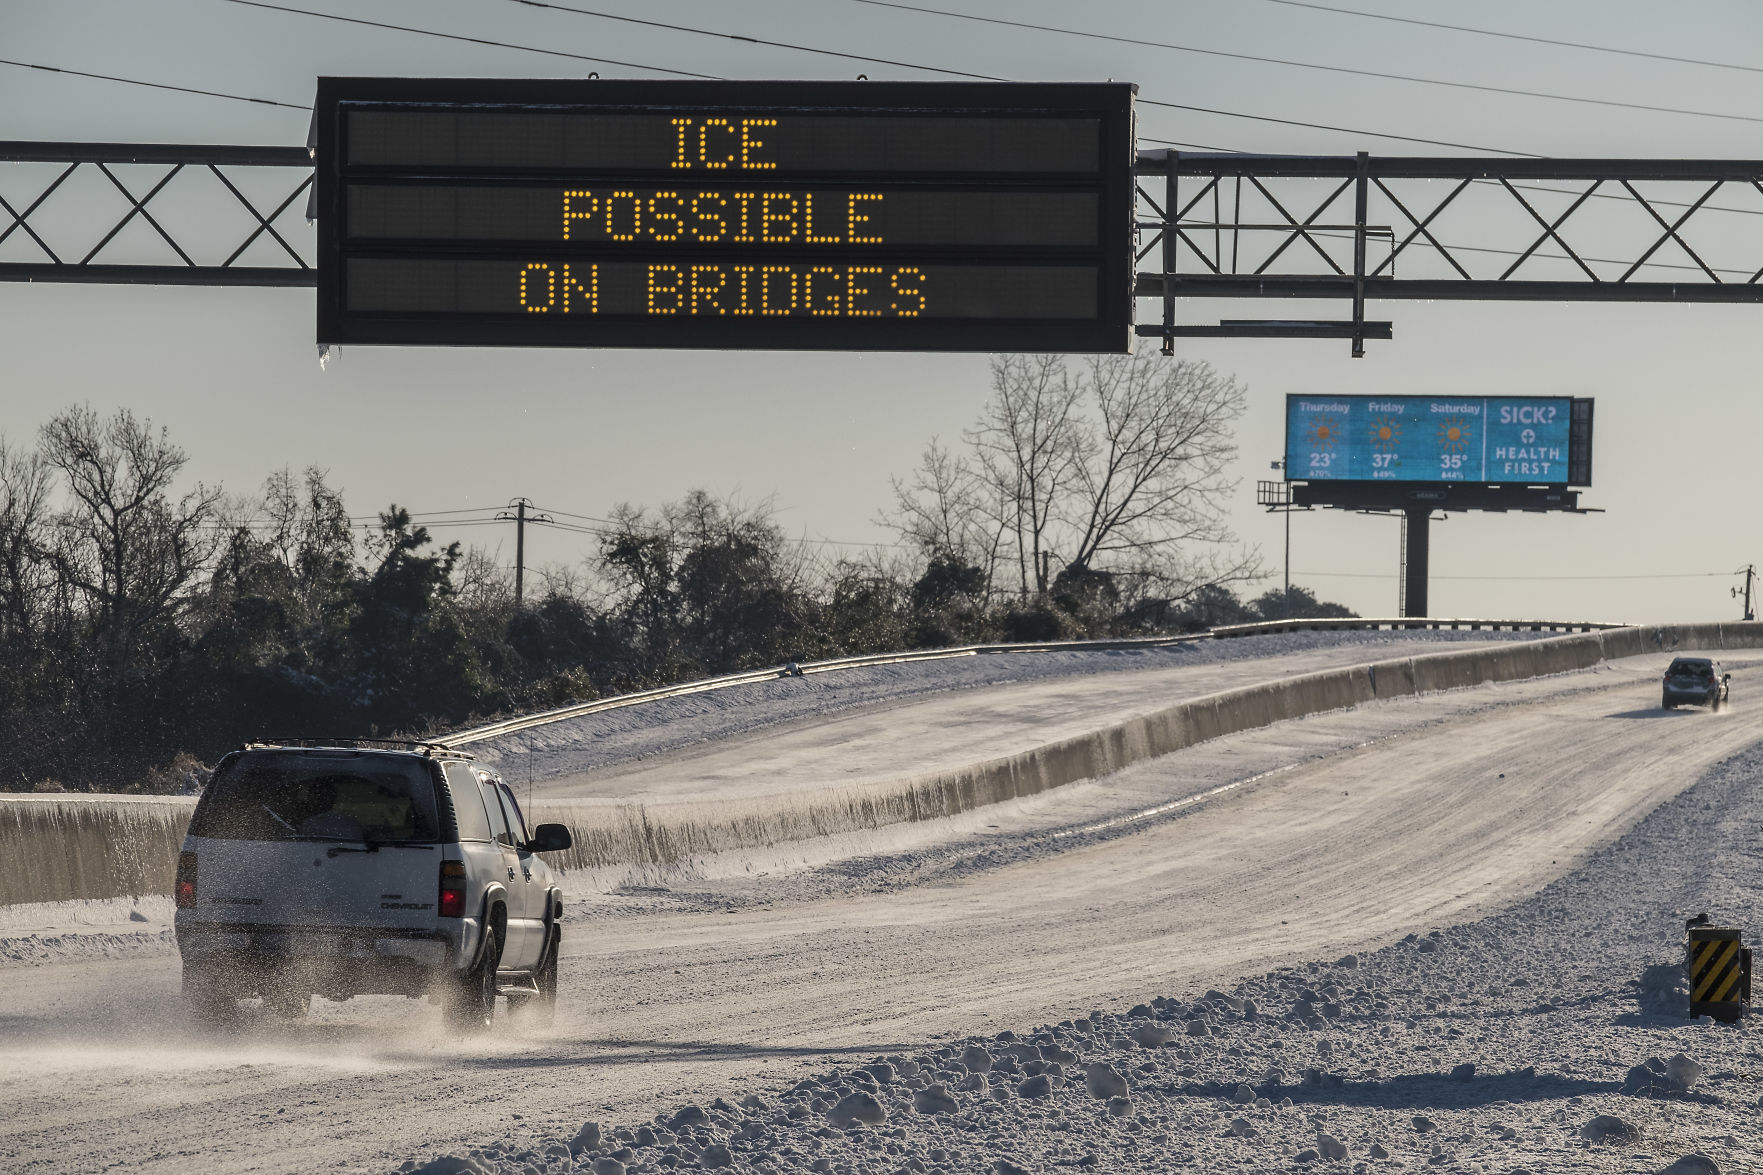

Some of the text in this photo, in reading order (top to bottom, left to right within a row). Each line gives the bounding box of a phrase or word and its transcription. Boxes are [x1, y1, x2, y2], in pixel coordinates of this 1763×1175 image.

[671, 118, 778, 169] ICE
[563, 190, 884, 243] POSSIBLE
[520, 262, 926, 316] ON BRIDGES
[1300, 402, 1350, 413] Thursday
[1368, 402, 1405, 413] Friday
[1430, 403, 1480, 415] Saturday
[1500, 406, 1557, 424] SICK?
[1495, 447, 1560, 460] HEALTH
[1504, 462, 1551, 475] FIRST
